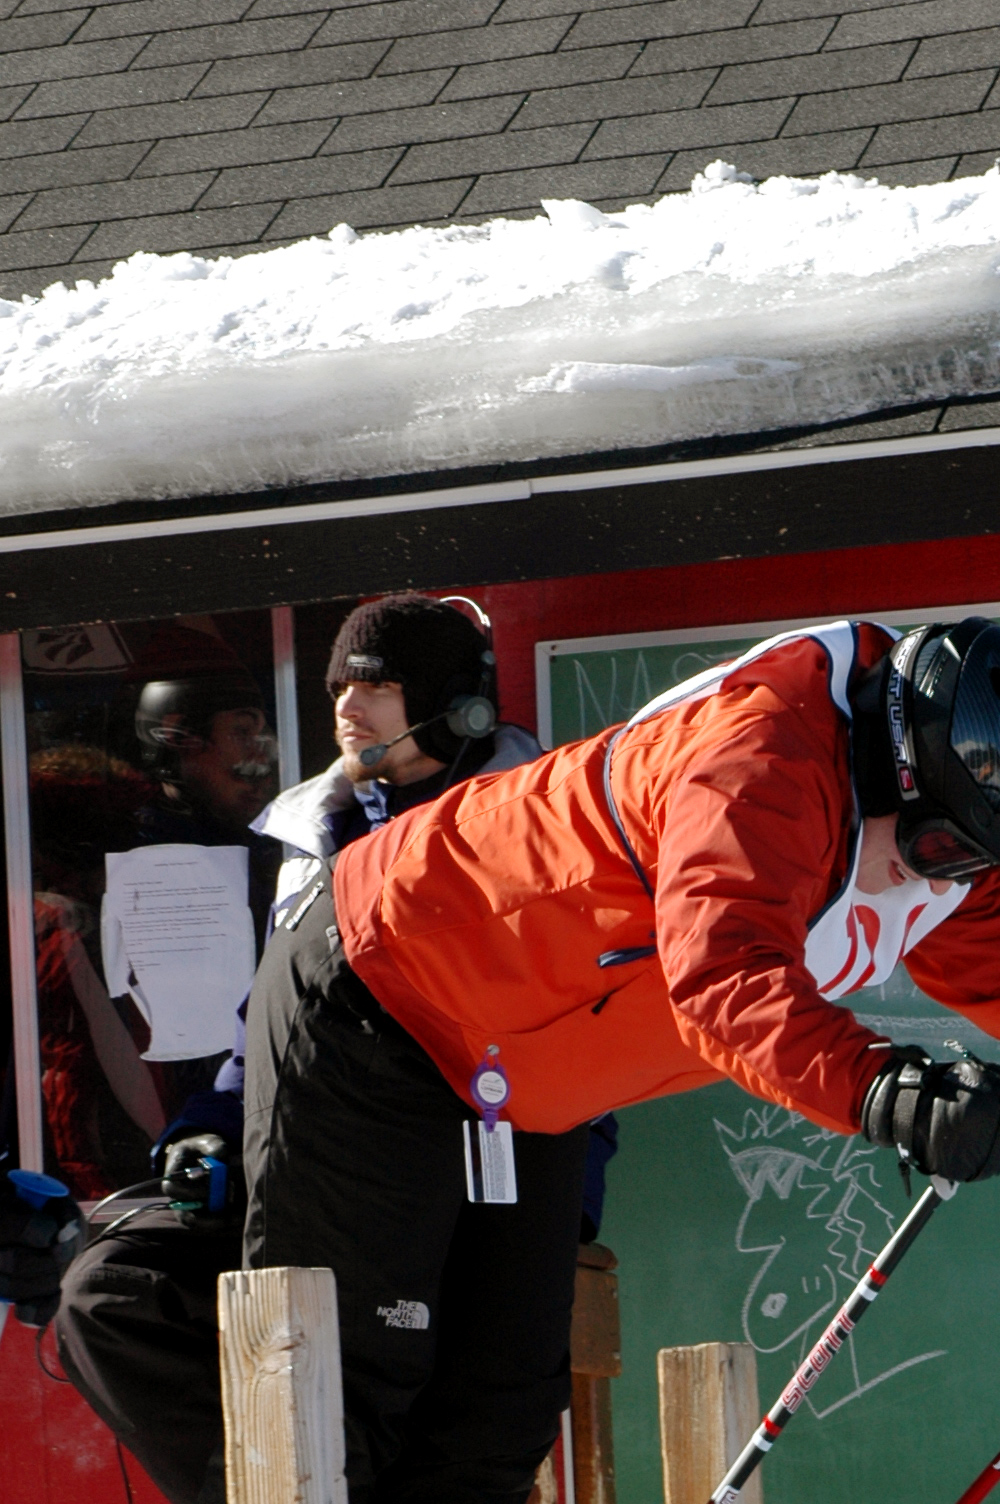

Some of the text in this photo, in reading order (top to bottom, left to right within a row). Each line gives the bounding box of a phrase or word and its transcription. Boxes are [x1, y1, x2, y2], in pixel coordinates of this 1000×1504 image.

[888, 704, 908, 765] USA
[396, 1299, 412, 1311] THE
[376, 1306, 414, 1320] NORTH
[385, 1317, 415, 1329] FACE
[782, 1305, 856, 1415] SCOTT
